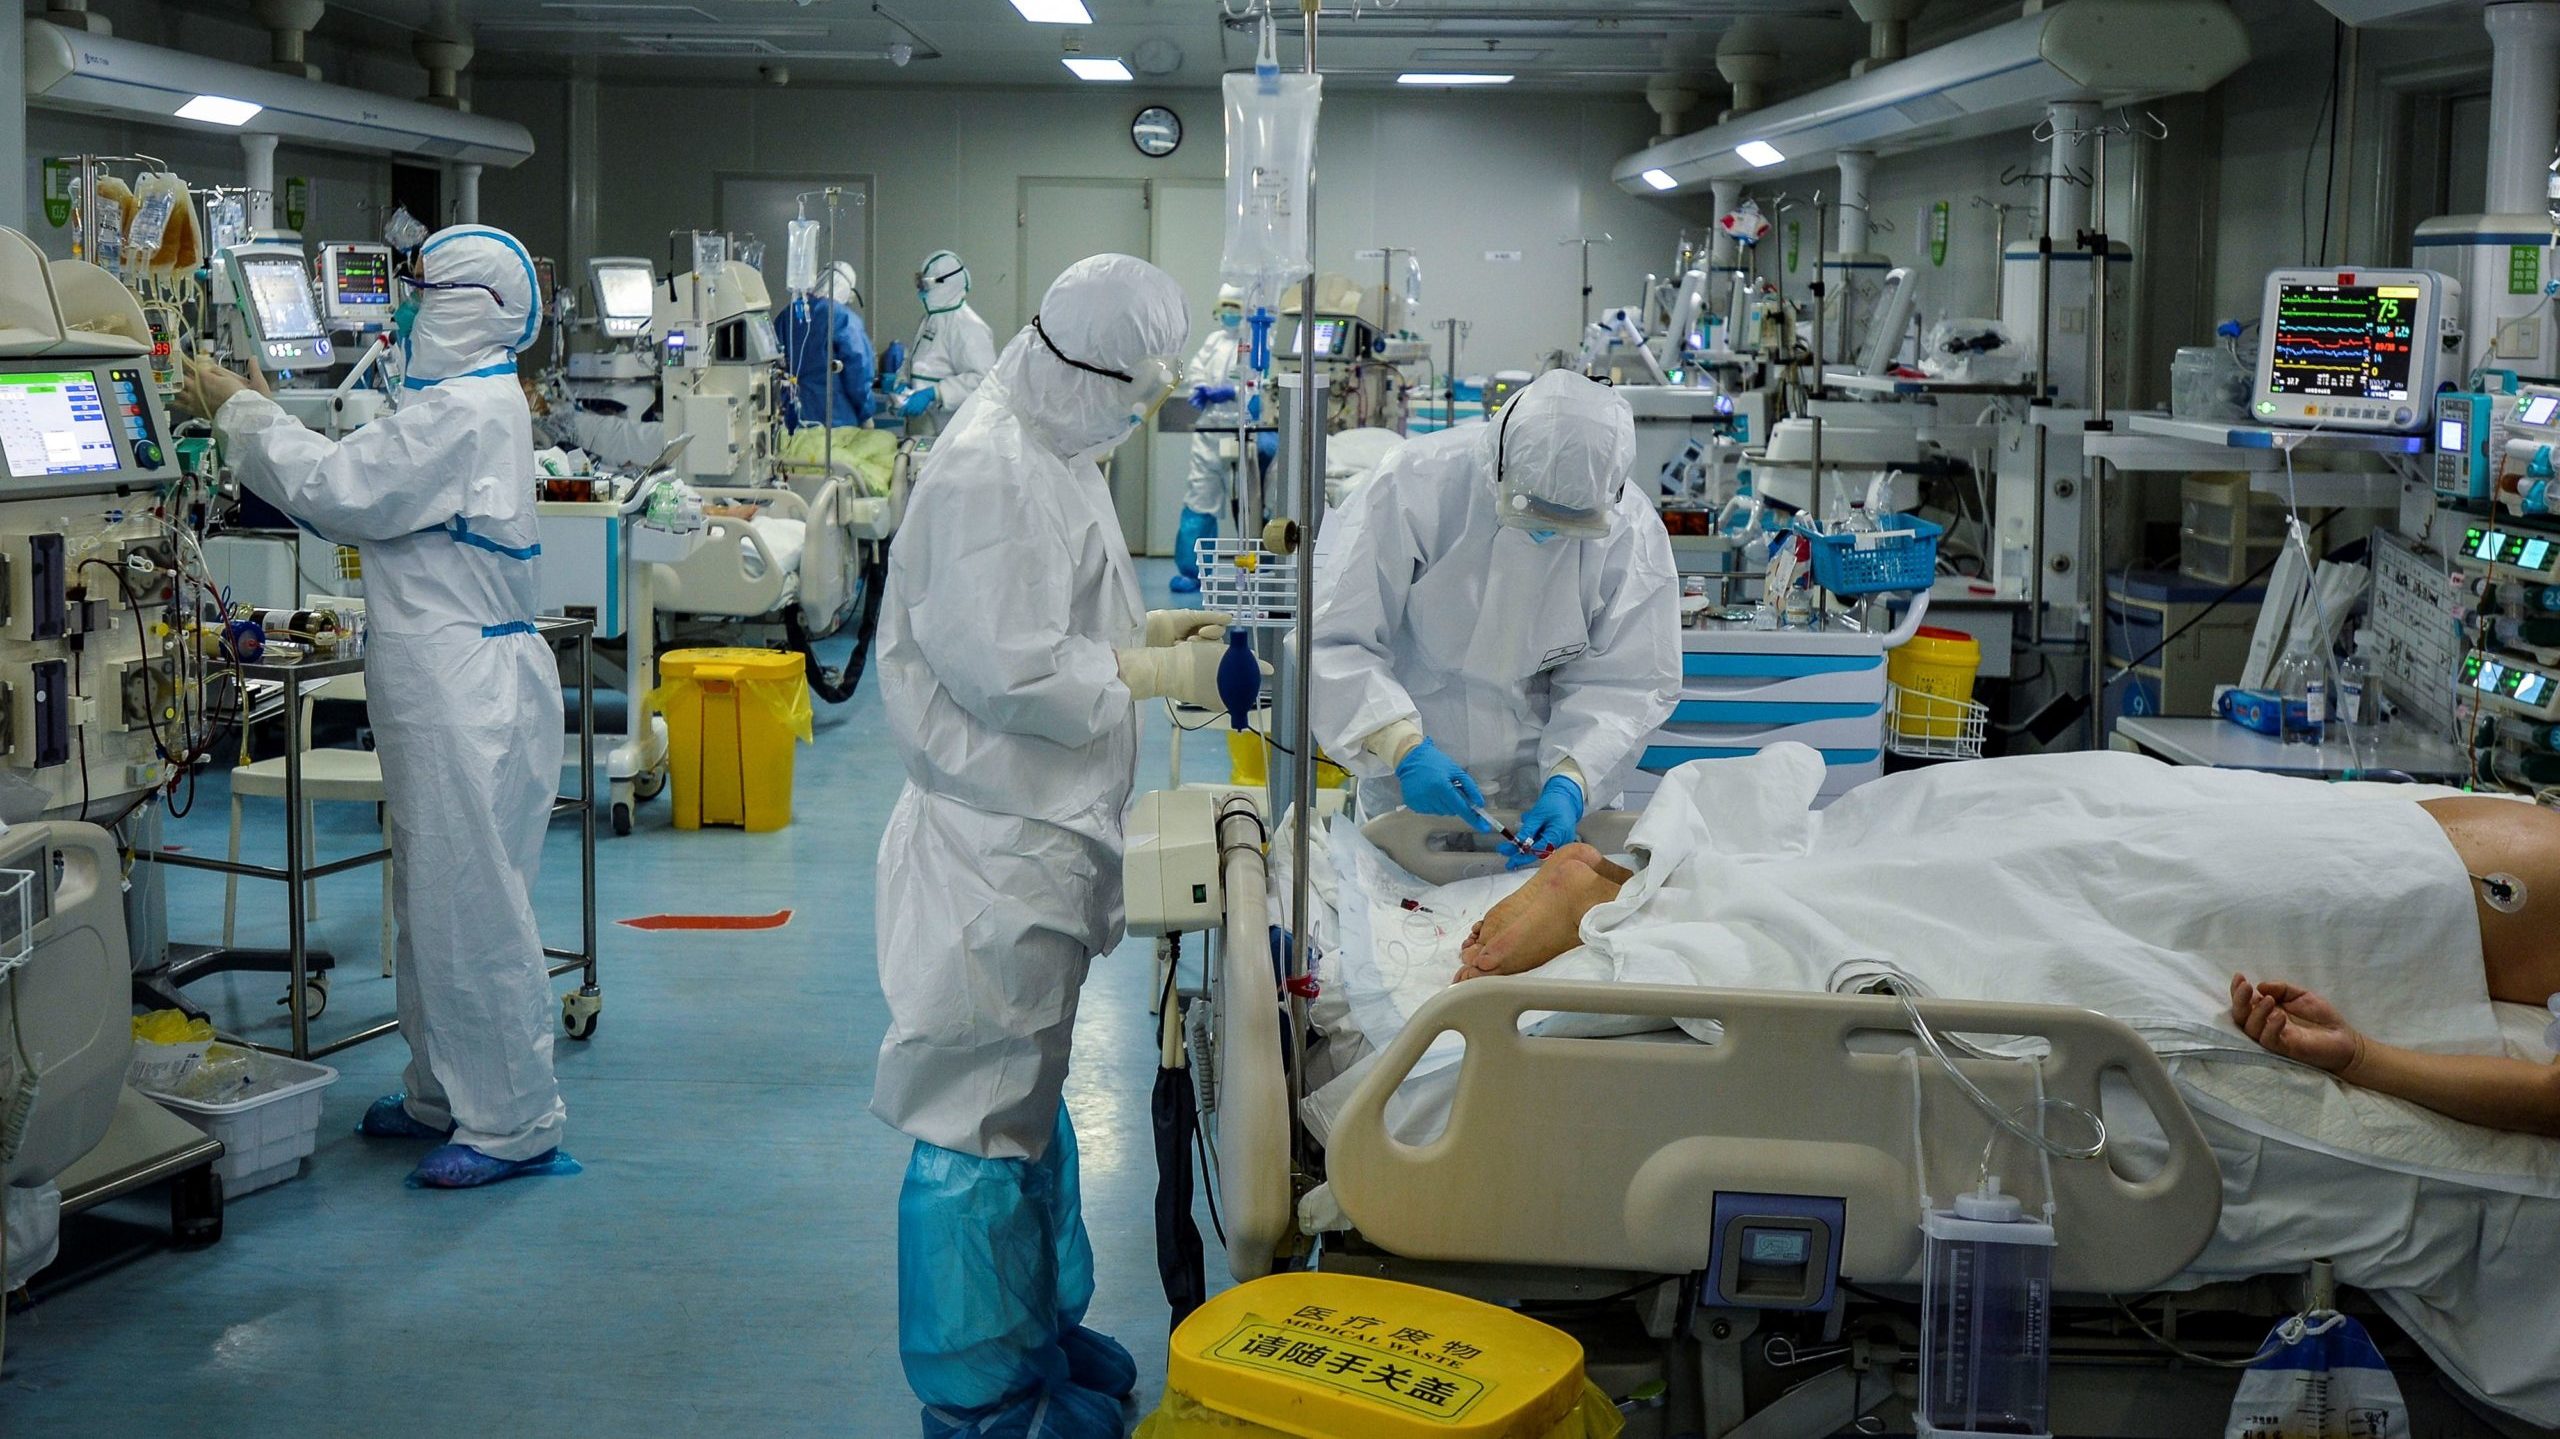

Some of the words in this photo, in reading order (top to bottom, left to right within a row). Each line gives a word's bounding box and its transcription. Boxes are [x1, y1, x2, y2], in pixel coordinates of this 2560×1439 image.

[2379, 299, 2399, 318] 75
[2371, 367, 2379, 377] 0
[2133, 695, 2144, 716] 9
[1282, 1317, 1380, 1345] MEDICAL
[1388, 1341, 1465, 1370] WASTE
[1293, 1305, 1483, 1360] 医疗废物
[1239, 1332, 1460, 1407] 请随手关盖
